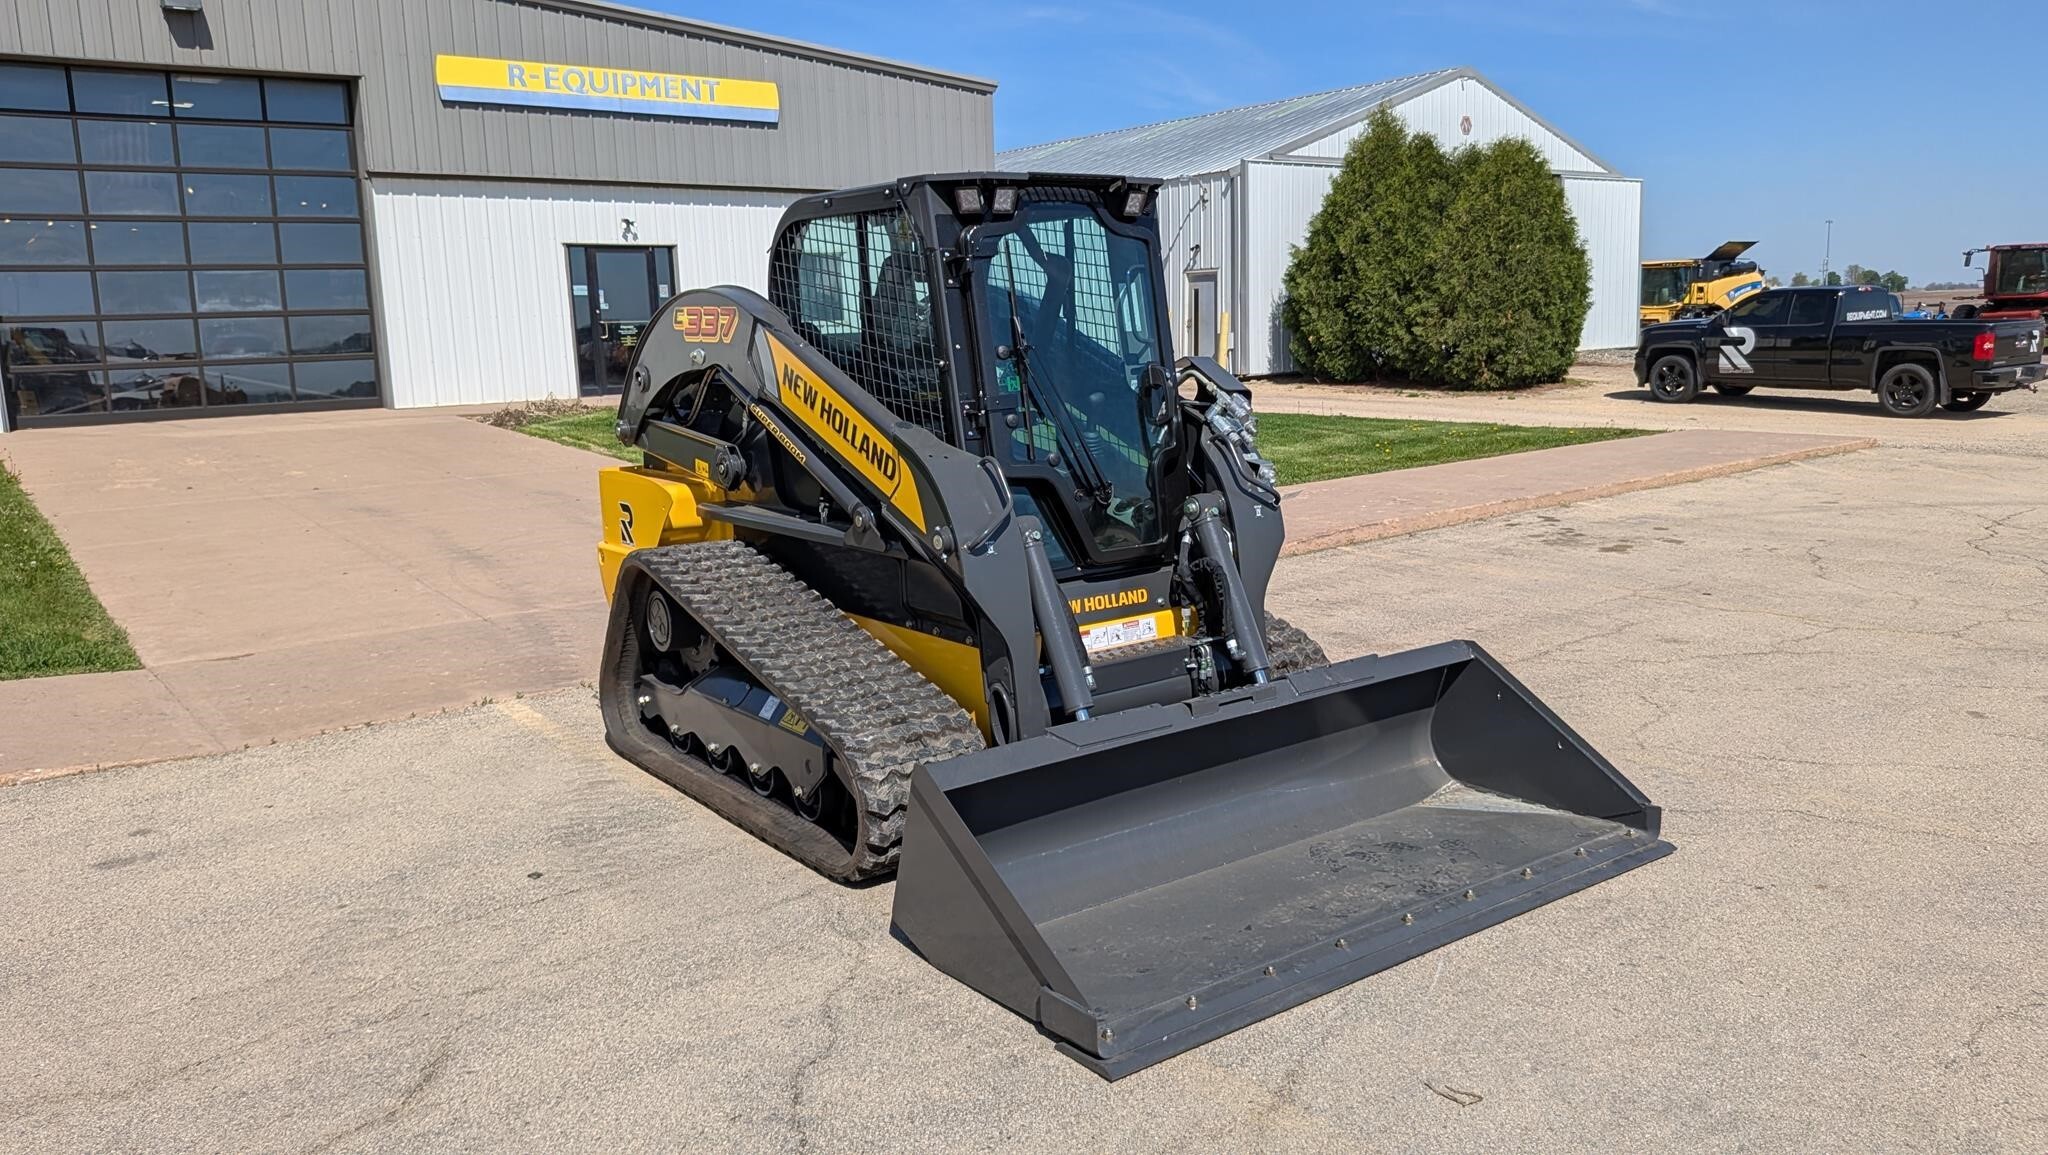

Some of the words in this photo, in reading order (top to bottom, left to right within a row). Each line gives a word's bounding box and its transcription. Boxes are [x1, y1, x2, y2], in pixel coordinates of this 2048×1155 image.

[507, 63, 721, 102] R-EQUIPMENT
[673, 306, 739, 343] C337
[782, 362, 818, 413] NEW
[819, 396, 897, 481] HOLLAND
[1084, 588, 1149, 612] HOLLAND
